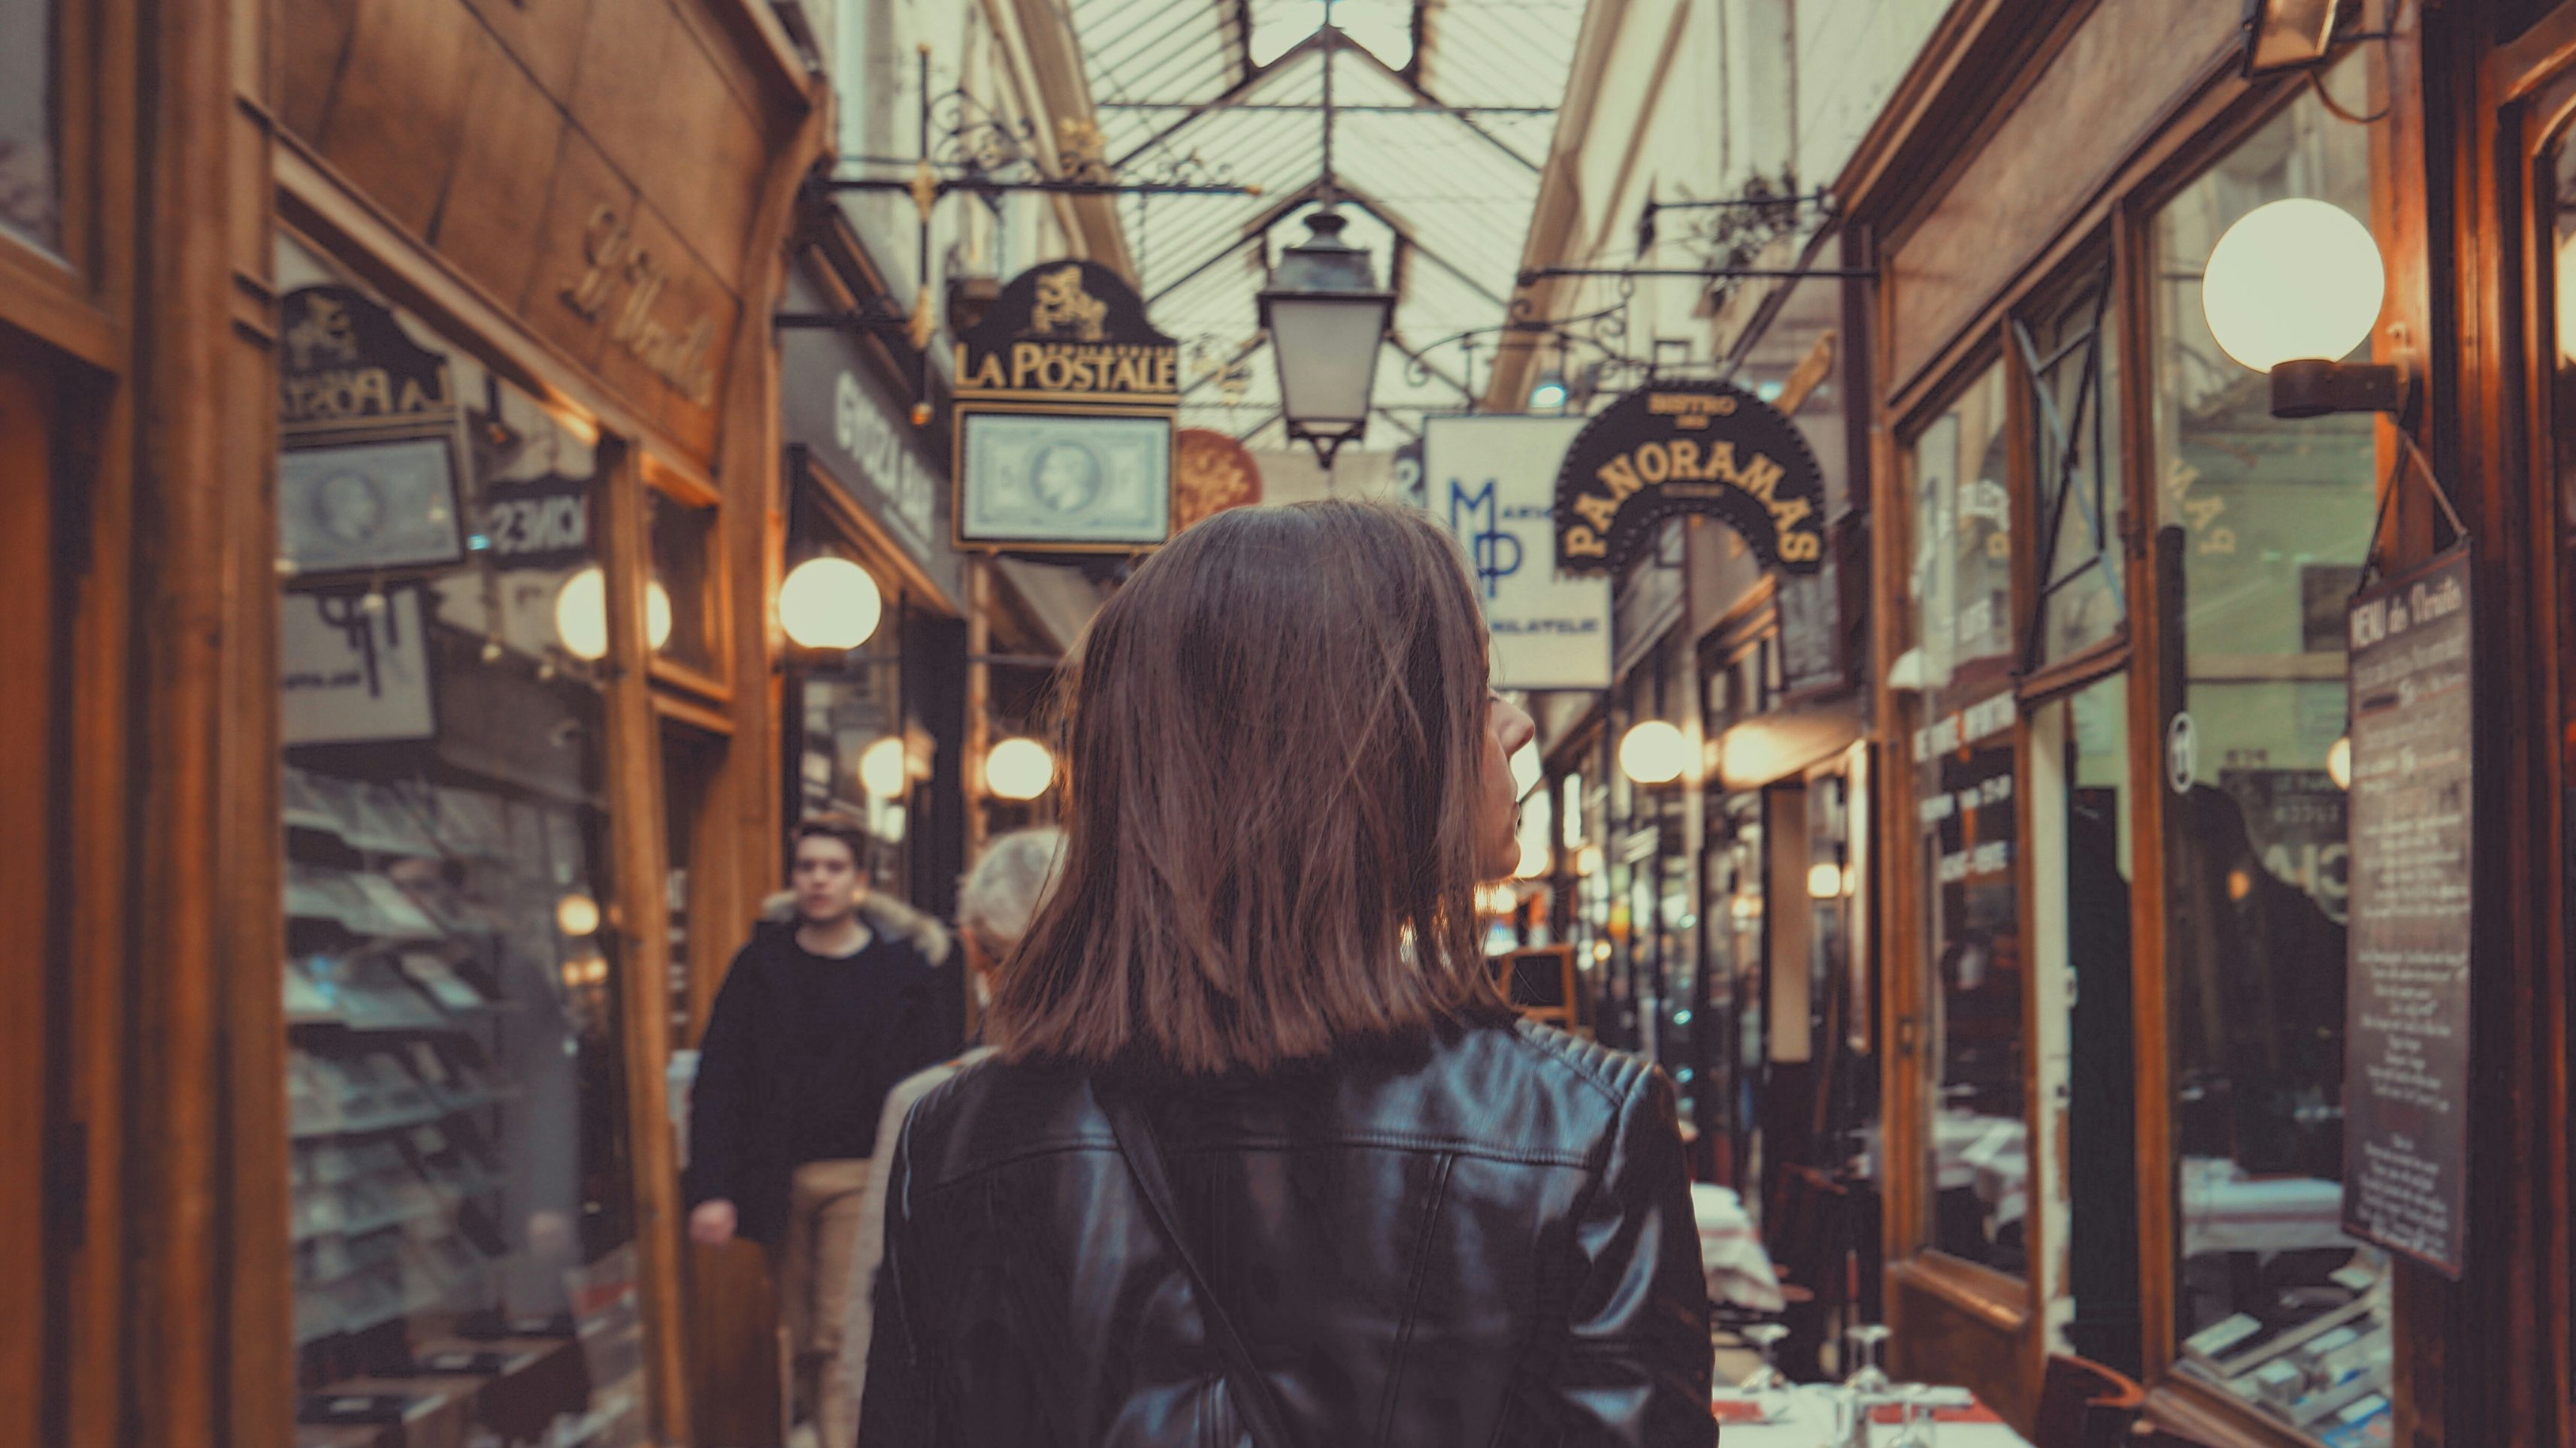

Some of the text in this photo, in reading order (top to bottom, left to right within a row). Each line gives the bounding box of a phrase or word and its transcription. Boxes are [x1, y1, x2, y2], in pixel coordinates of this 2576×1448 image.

[954, 341, 1176, 392] LA POSTALE
[1648, 392, 1738, 416] BISTRO
[1564, 439, 1821, 564] PANORAMAS
